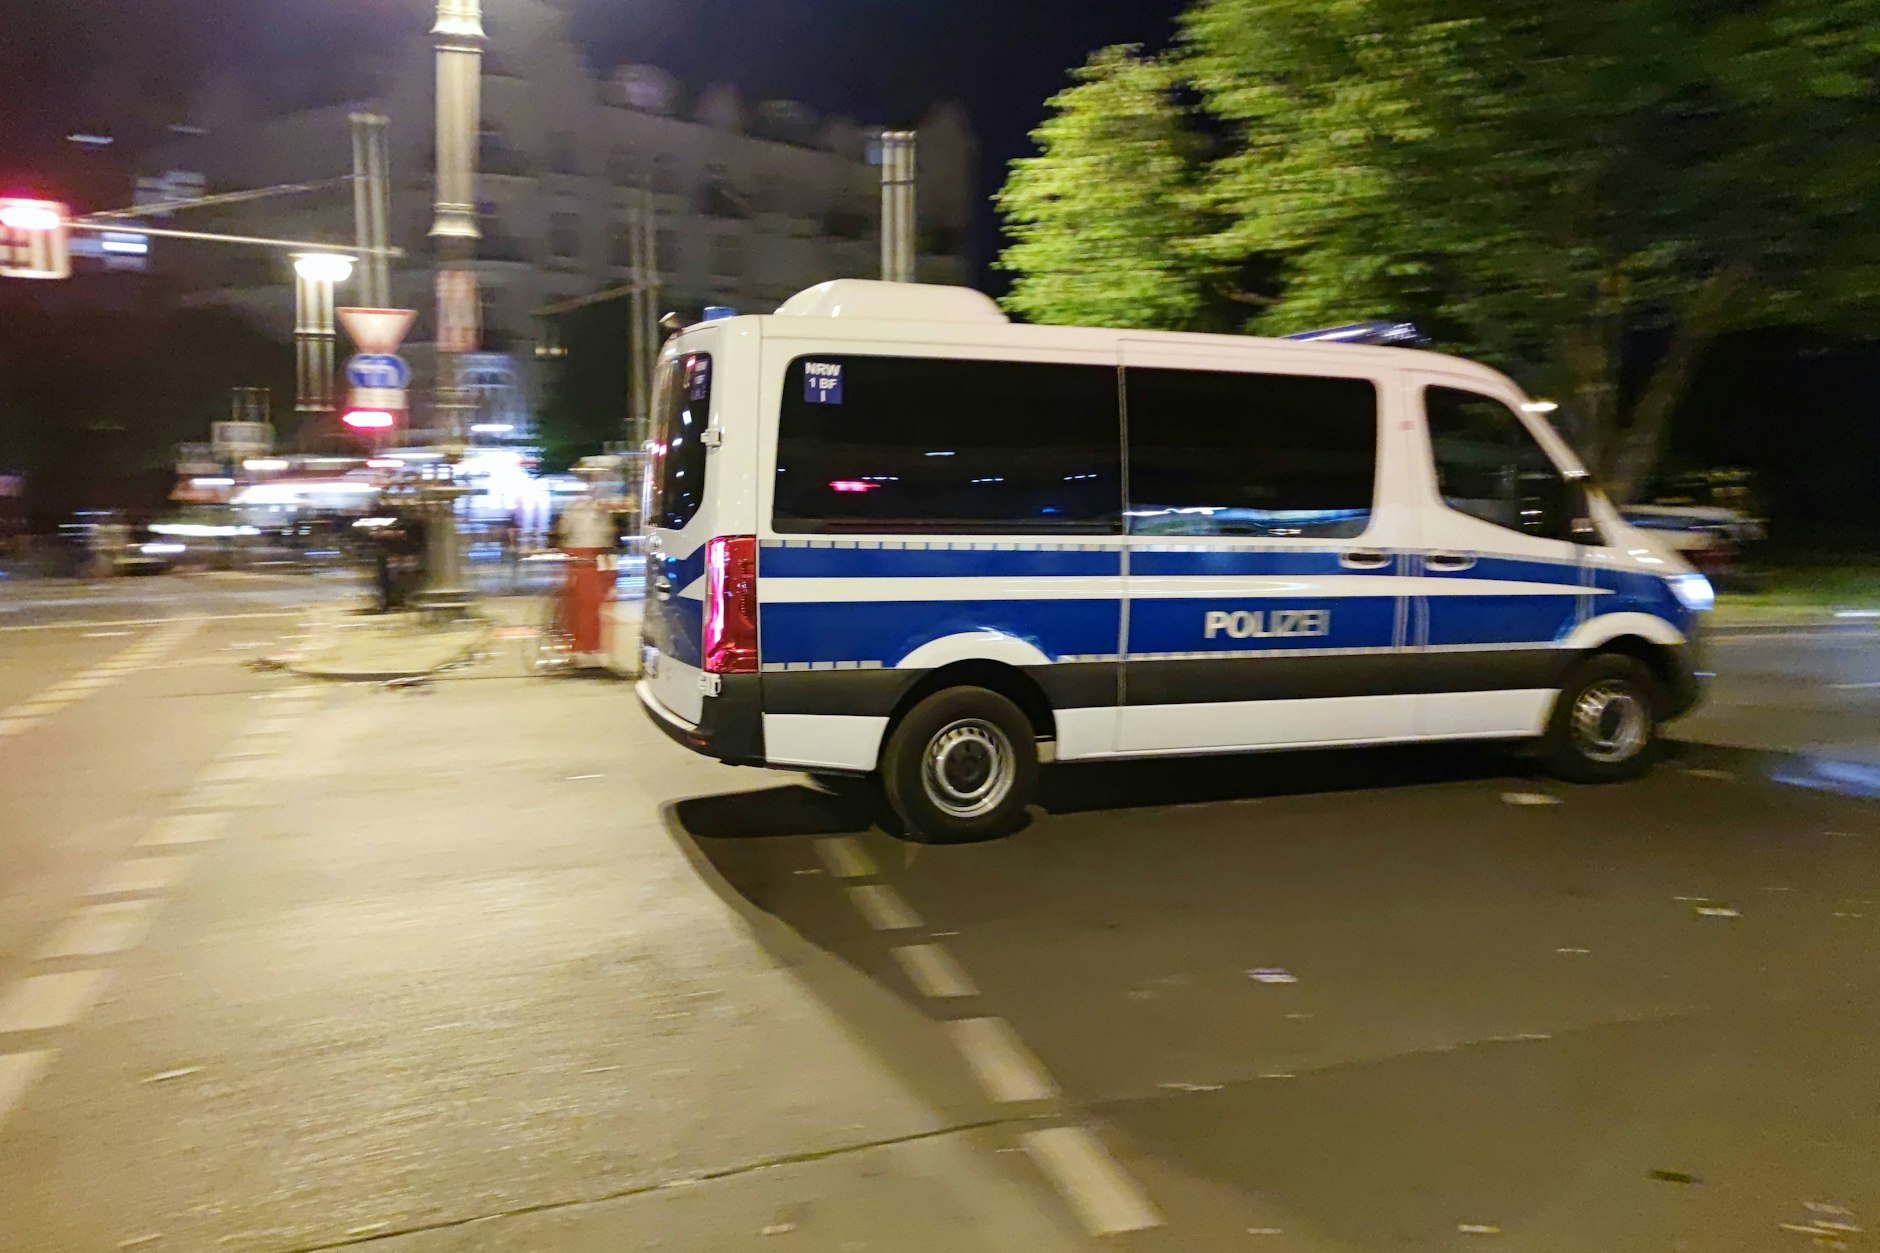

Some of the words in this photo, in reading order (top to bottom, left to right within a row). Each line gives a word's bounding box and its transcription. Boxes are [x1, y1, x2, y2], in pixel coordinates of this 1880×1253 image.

[805, 362, 841, 377] NRW
[808, 377, 816, 388] 1
[819, 377, 838, 389] BF
[1204, 610, 1331, 639] POLIZEI
